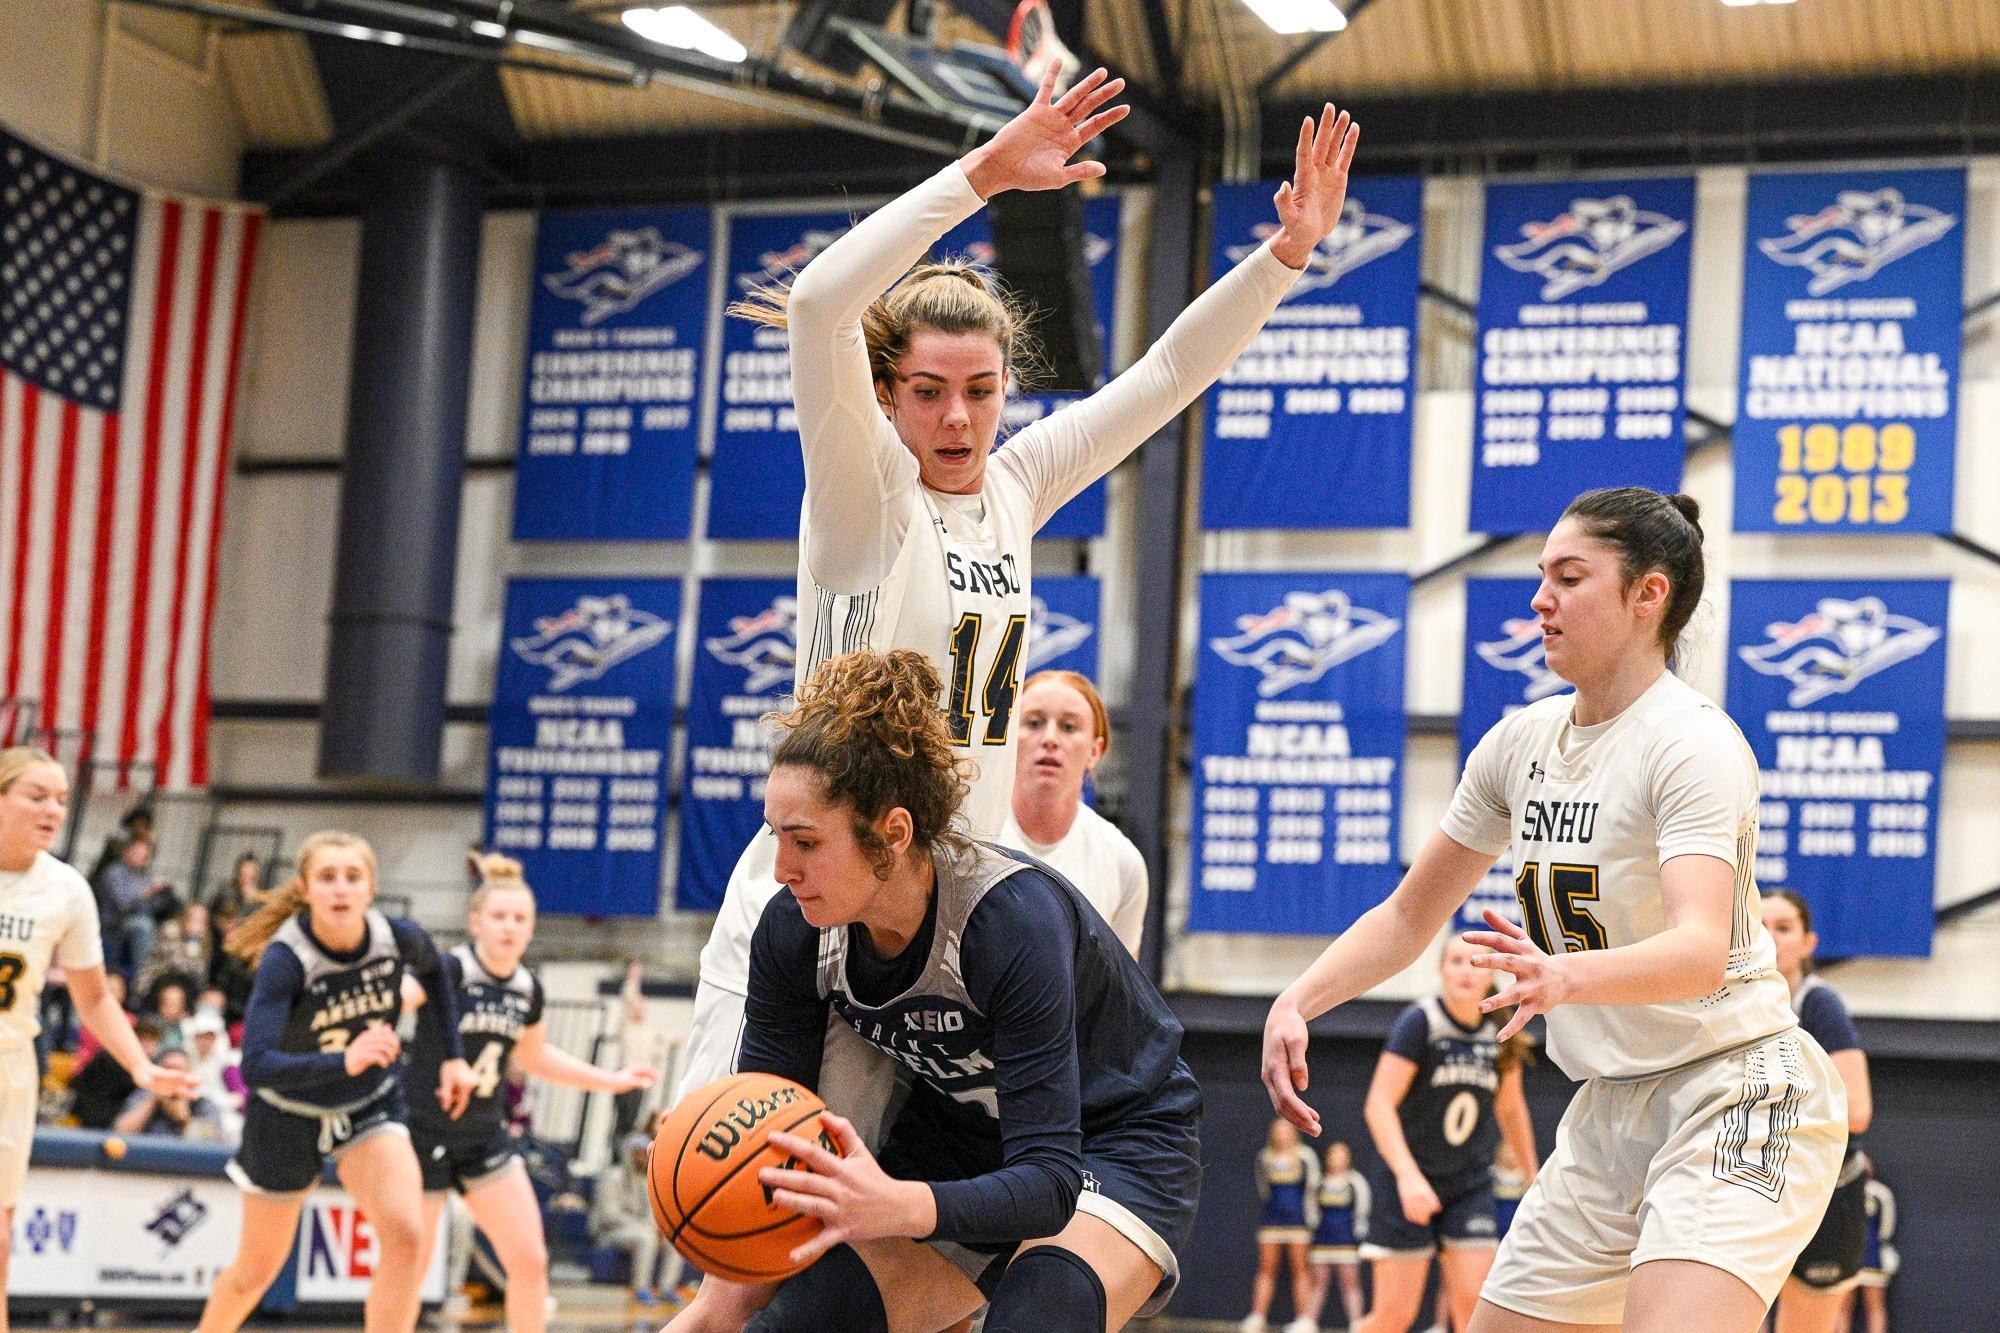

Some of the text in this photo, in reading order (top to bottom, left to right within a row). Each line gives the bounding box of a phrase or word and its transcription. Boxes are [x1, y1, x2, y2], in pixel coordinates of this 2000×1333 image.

[1246, 326, 1408, 355] NFERENCE
[1796, 321, 1904, 354] NCAA
[1750, 353, 1948, 387] NATIONAL
[1746, 387, 1948, 419] CHAMPIONS
[1776, 423, 1917, 473] 1989
[1773, 473, 1910, 524] 2013
[947, 551, 1021, 597] SNHU
[942, 612, 1027, 747] 14
[1247, 723, 1351, 756] NCAA
[1776, 736, 1885, 770] NCAA
[1521, 800, 1600, 844] SNHU
[0, 914, 34, 941] HU
[1515, 861, 1610, 953] 15
[854, 1019, 950, 1056] SAINT
[471, 1041, 504, 1099] 4
[696, 1087, 800, 1161] Wilson
[1443, 1090, 1479, 1147] 0
